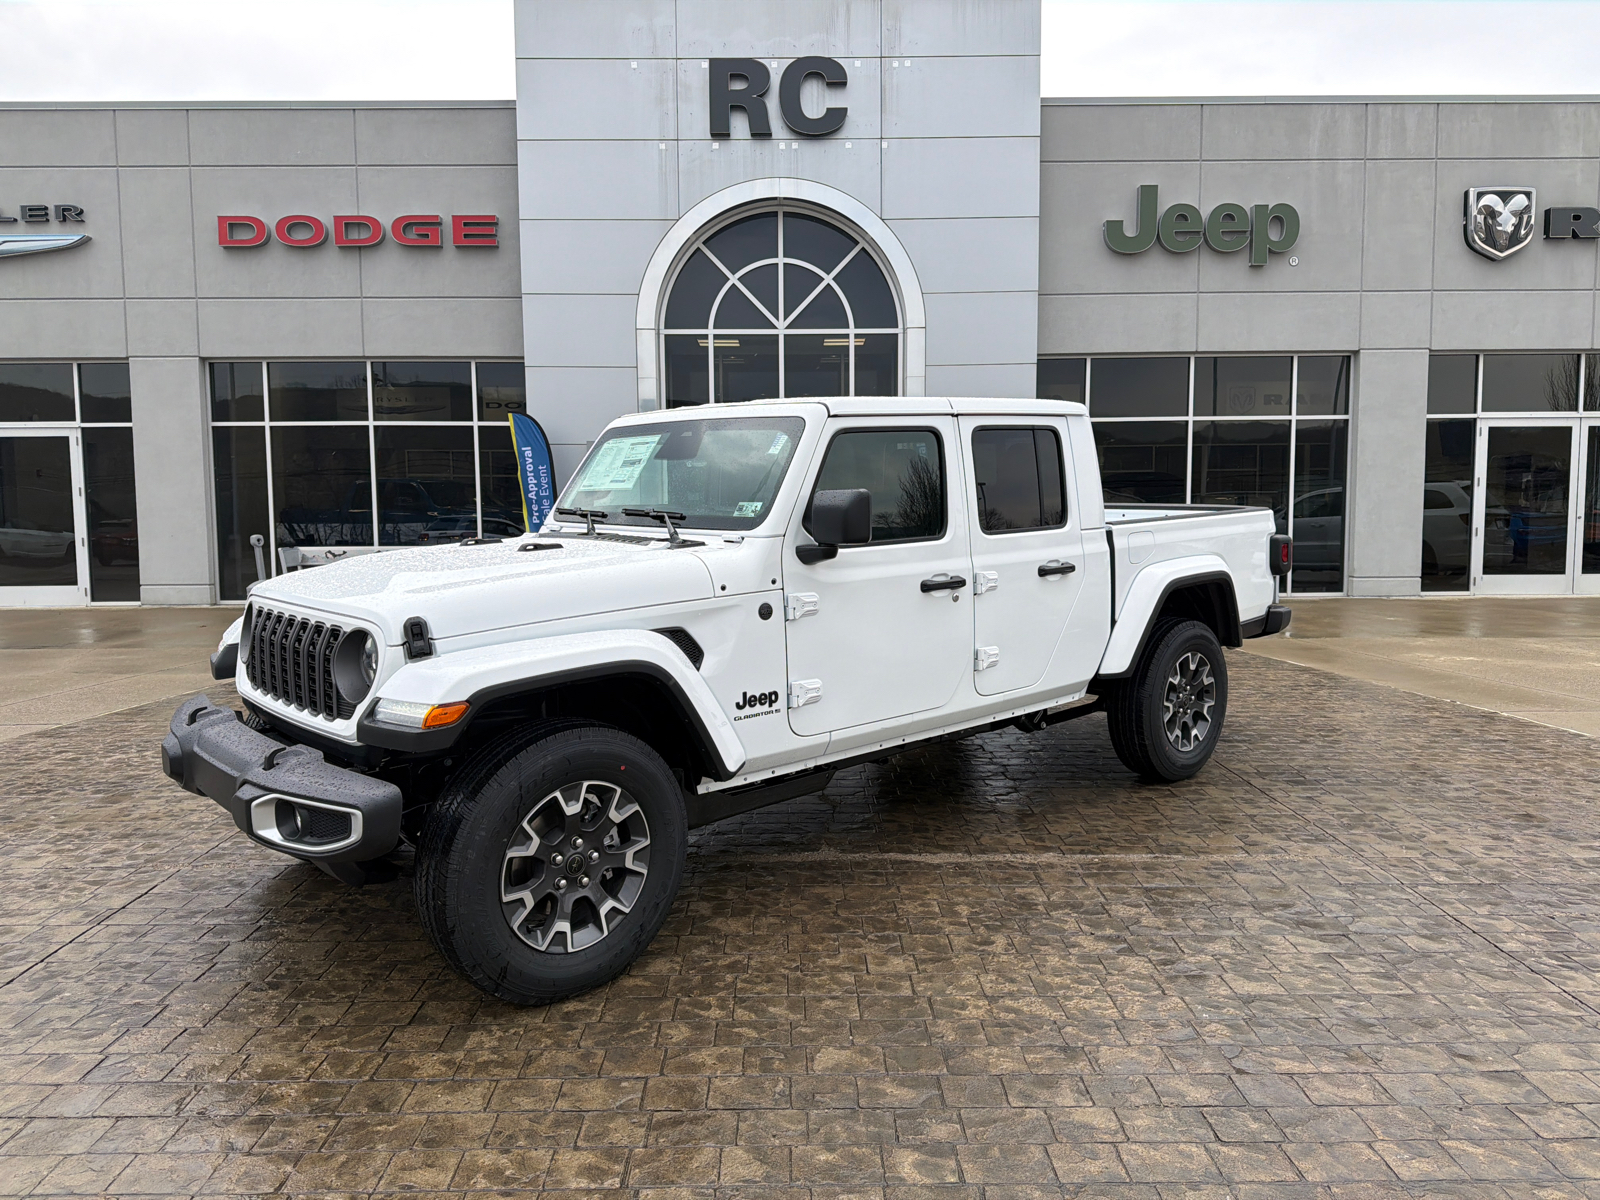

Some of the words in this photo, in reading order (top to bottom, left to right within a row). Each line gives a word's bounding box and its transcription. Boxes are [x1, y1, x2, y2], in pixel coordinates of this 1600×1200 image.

[709, 56, 848, 138] RC
[217, 215, 499, 249] DODGE
[1103, 184, 1300, 267] Jeep
[521, 446, 540, 523] Pre-Approval
[538, 464, 550, 495] Event
[733, 709, 774, 722] GLADIATOR
[735, 690, 779, 710] Jeep
